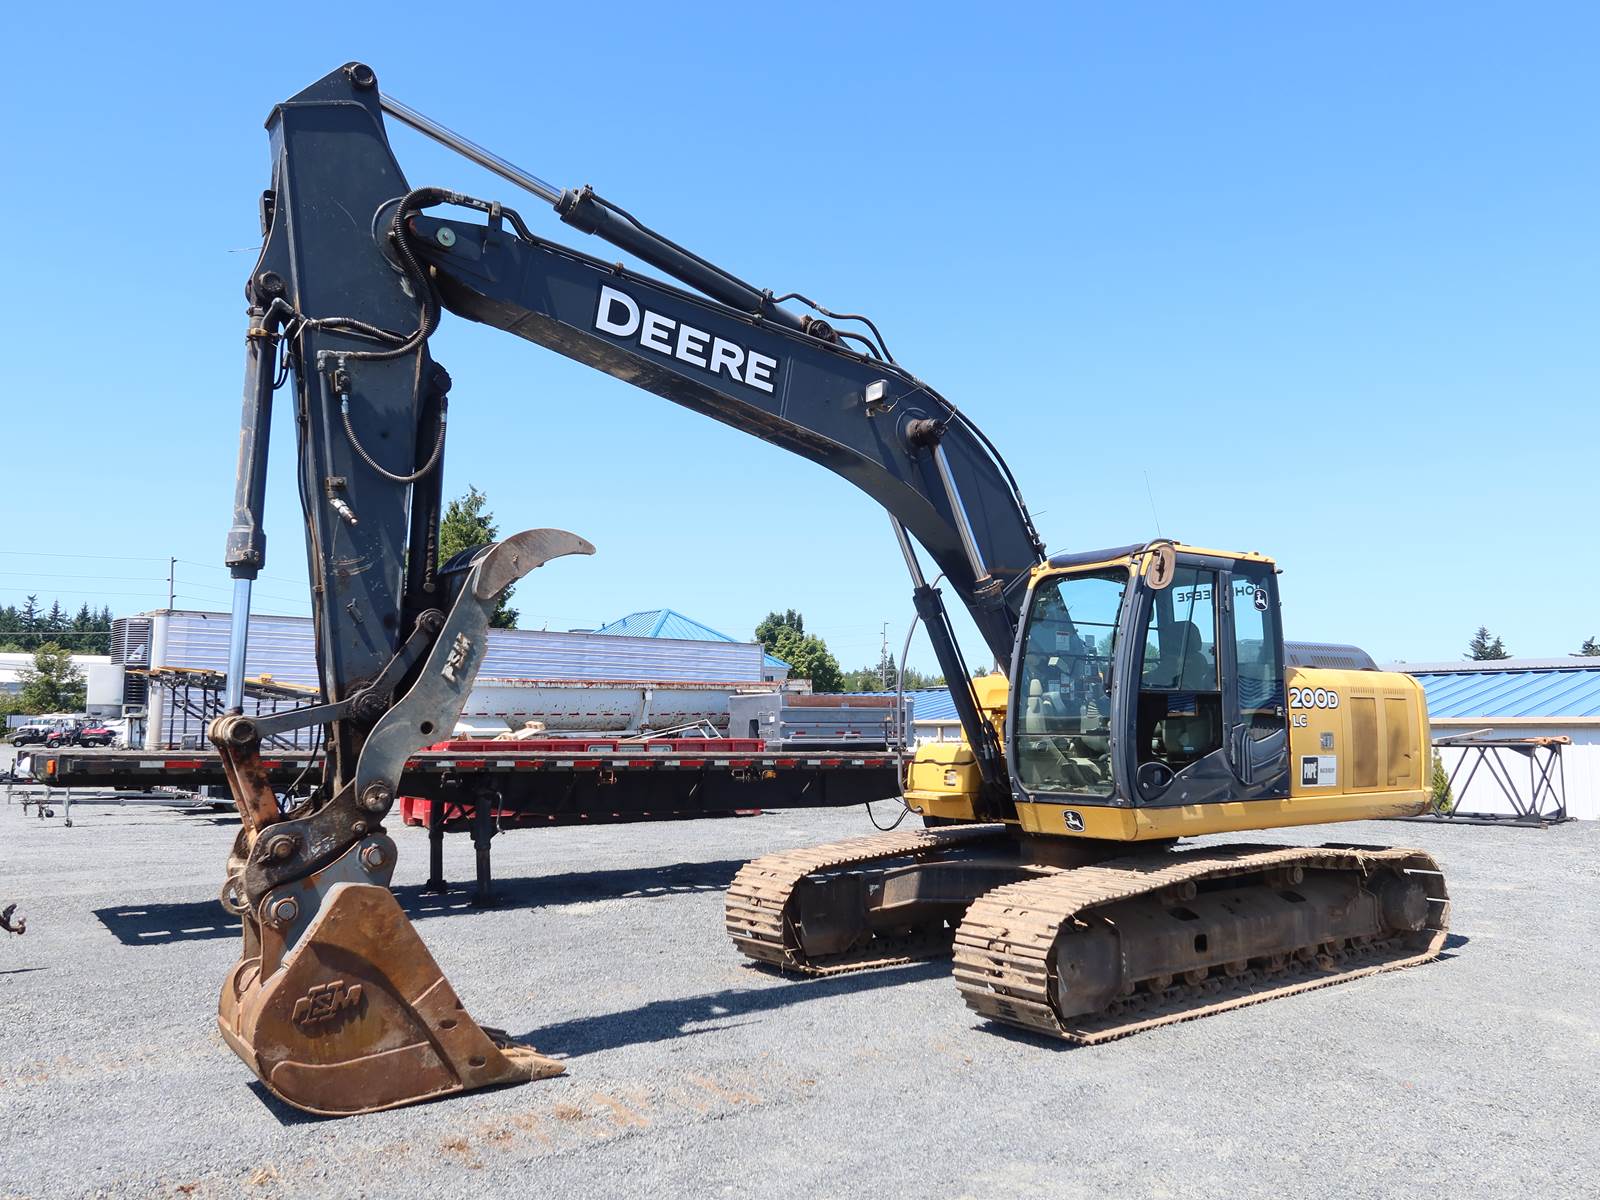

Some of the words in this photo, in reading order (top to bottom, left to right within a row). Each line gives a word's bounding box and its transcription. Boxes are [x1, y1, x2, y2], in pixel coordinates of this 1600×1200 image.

[596, 285, 777, 393] DEERE
[1289, 687, 1339, 710] 200D
[1292, 714, 1308, 727] LC
